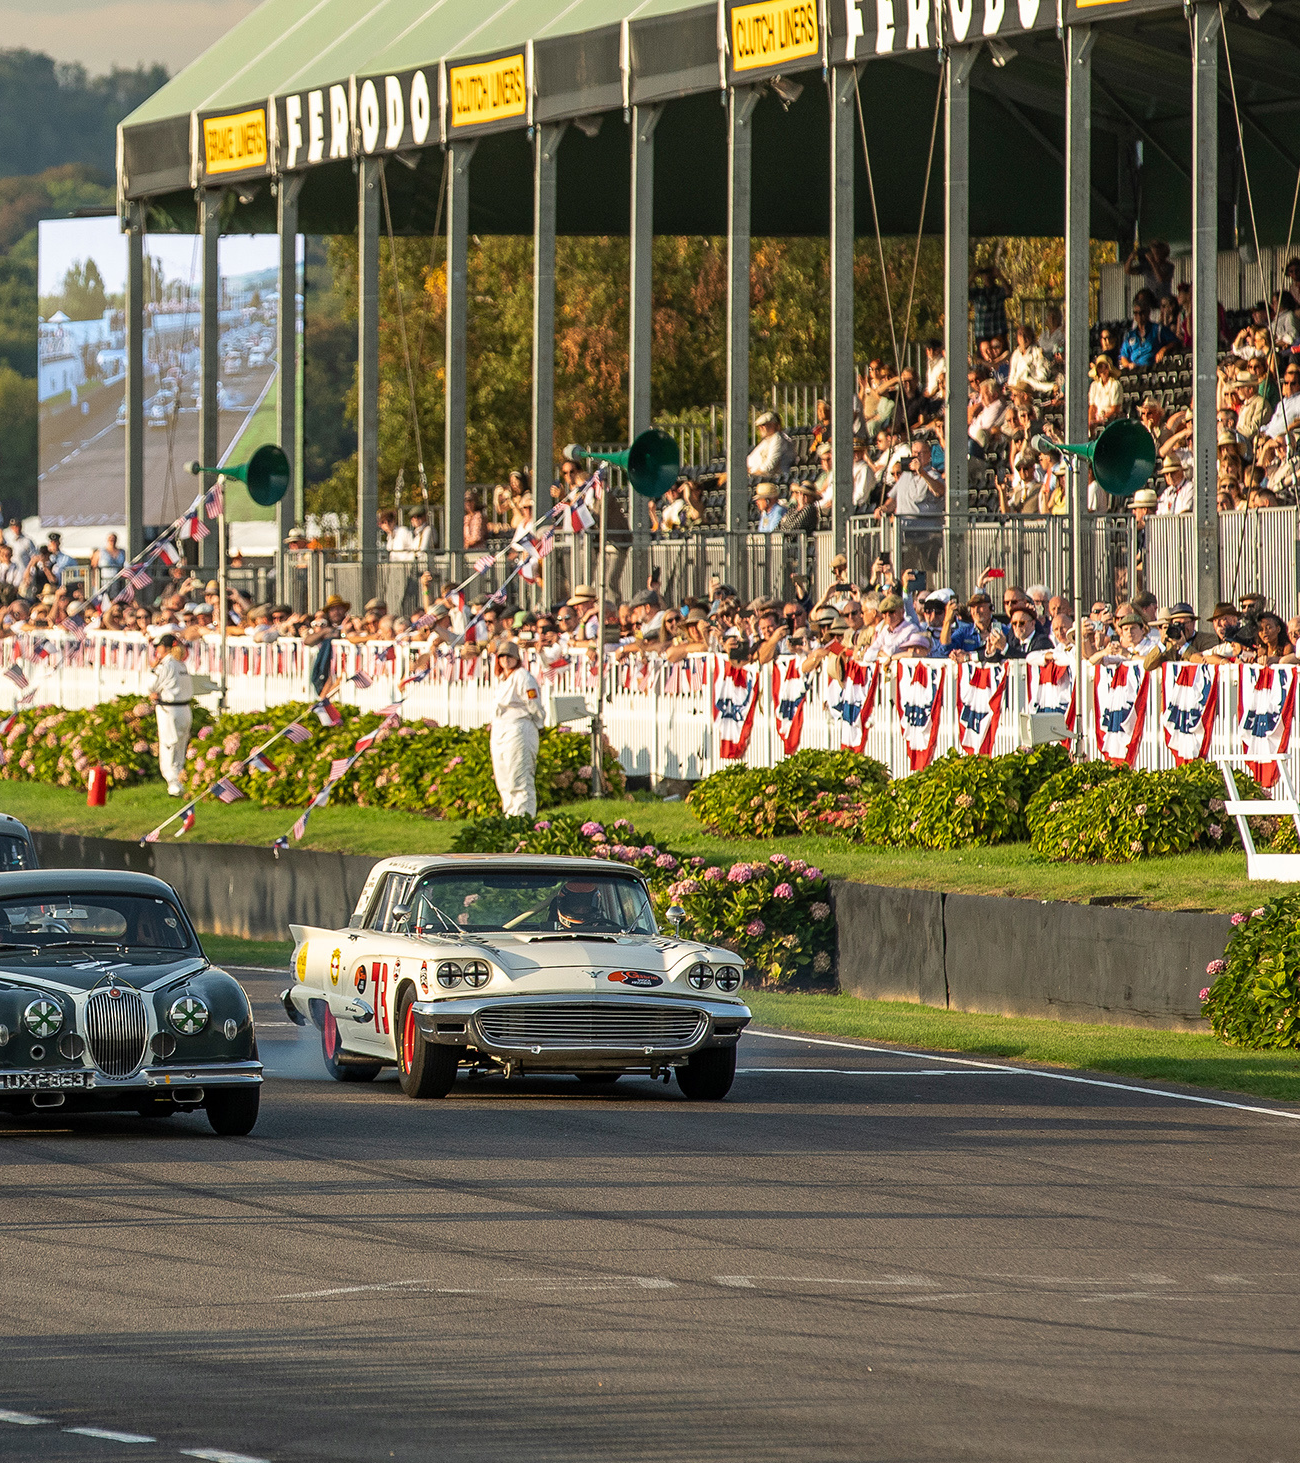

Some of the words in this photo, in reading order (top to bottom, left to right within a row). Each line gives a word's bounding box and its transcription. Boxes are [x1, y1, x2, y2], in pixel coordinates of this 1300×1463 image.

[736, 14, 775, 58] CLUTCH
[780, 2, 815, 49] LINERS
[286, 70, 430, 169] FERODO
[456, 74, 489, 114] CLUTCH
[490, 66, 522, 107] LINERS
[371, 961, 390, 1035] 73
